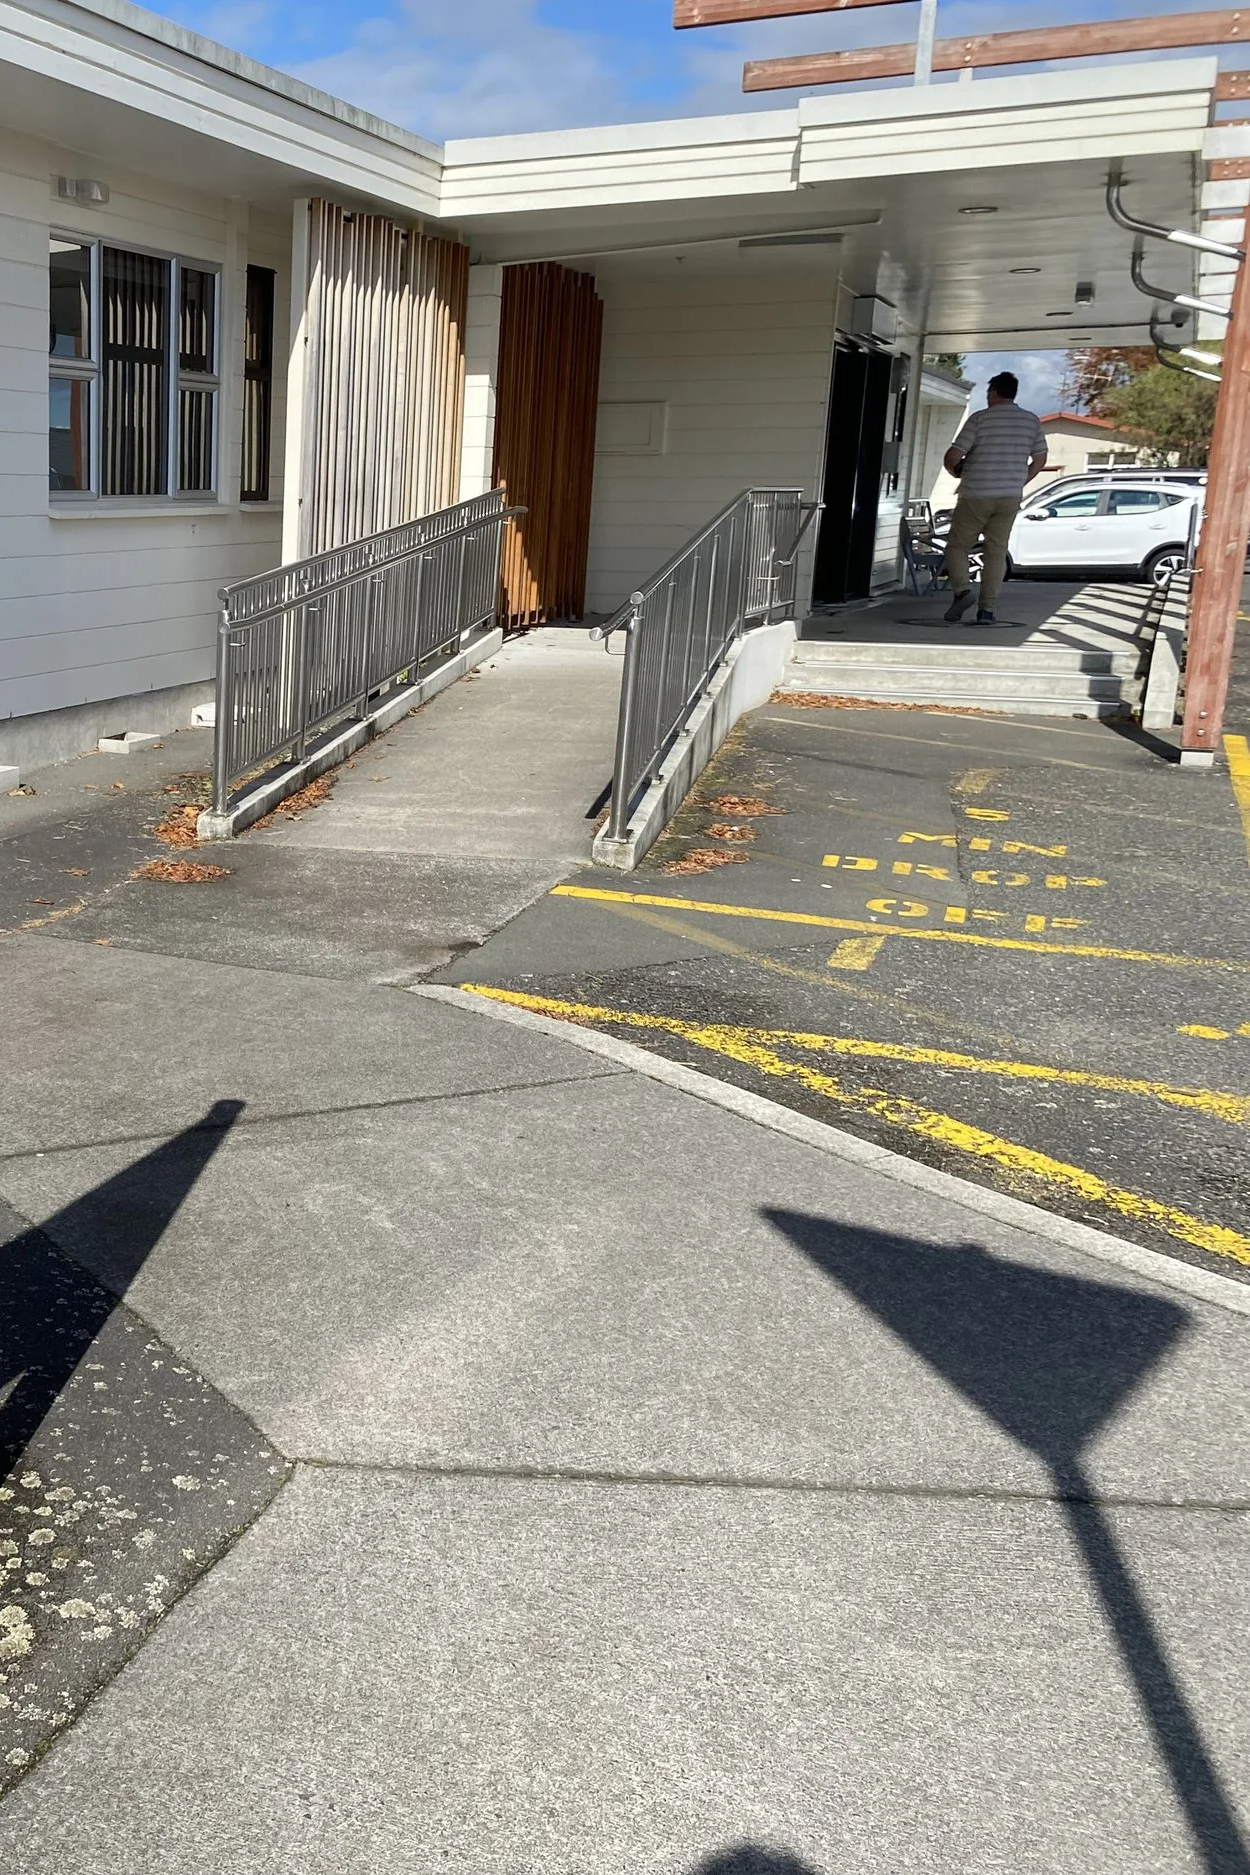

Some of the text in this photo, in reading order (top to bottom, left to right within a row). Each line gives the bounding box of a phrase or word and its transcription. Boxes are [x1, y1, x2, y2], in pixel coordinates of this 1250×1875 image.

[964, 806, 1011, 822] 5
[897, 831, 1067, 857] MIN
[821, 854, 1108, 890] DROP
[865, 897, 1090, 933] OFF
